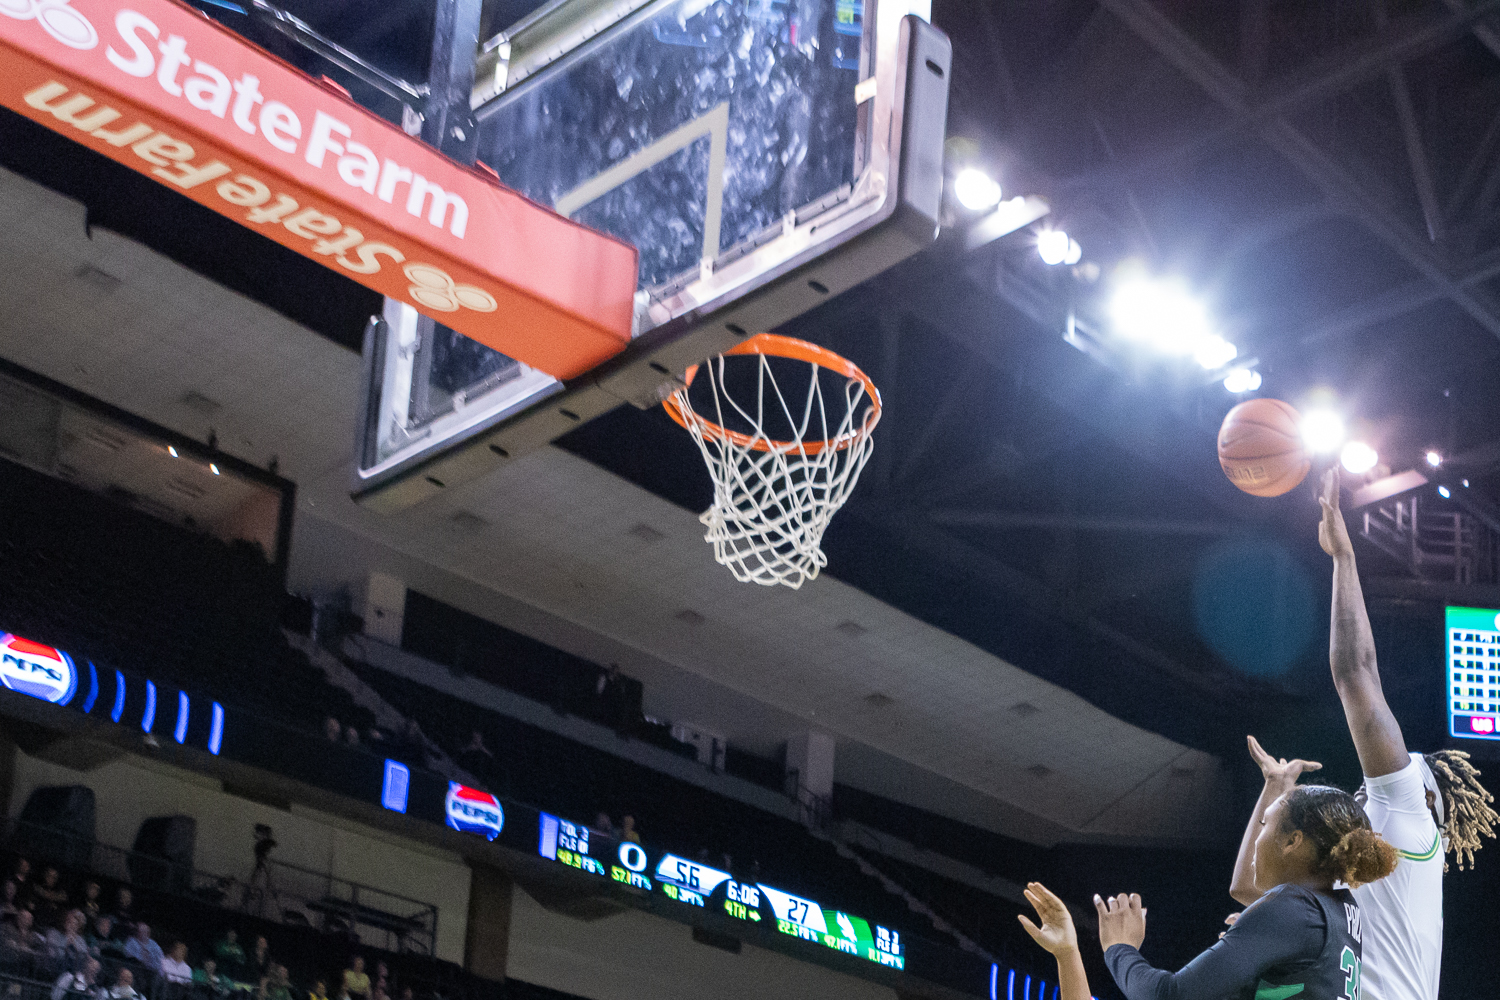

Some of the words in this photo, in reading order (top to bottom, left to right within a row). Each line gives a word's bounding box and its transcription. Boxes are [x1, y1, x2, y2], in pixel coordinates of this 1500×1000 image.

[2, 653, 63, 682] PEPSI
[451, 800, 499, 825] PEPSI
[676, 861, 700, 889] 56
[726, 879, 760, 908] 6:06
[723, 899, 747, 921] 4TH
[787, 898, 809, 925] 27
